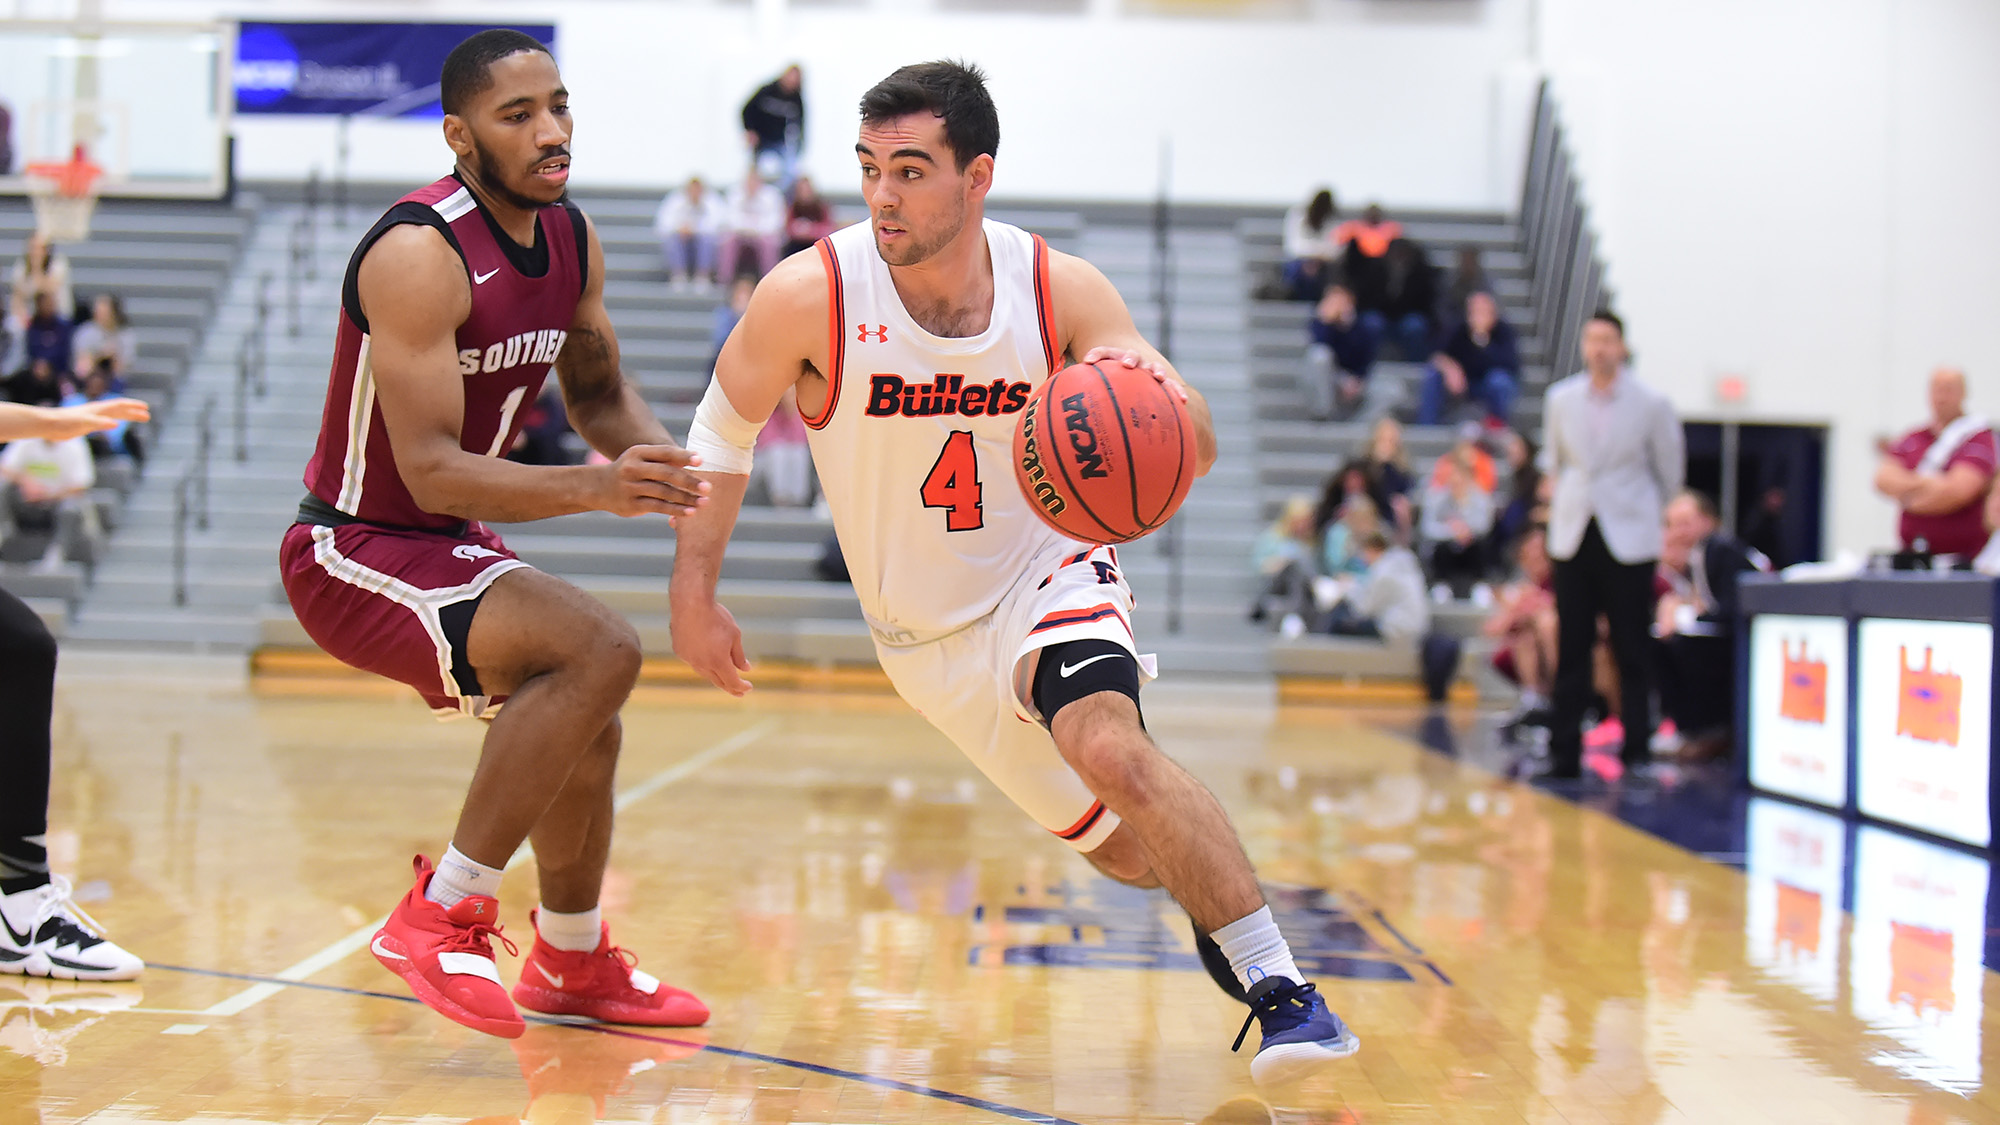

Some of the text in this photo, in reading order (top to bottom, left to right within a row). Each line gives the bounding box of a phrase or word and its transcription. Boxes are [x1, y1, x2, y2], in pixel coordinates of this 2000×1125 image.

[486, 386, 528, 457] 1
[865, 374, 1031, 417] Bullets
[1061, 392, 1108, 480] NCAA
[920, 430, 984, 532] 4
[1022, 395, 1068, 519] Wilson
